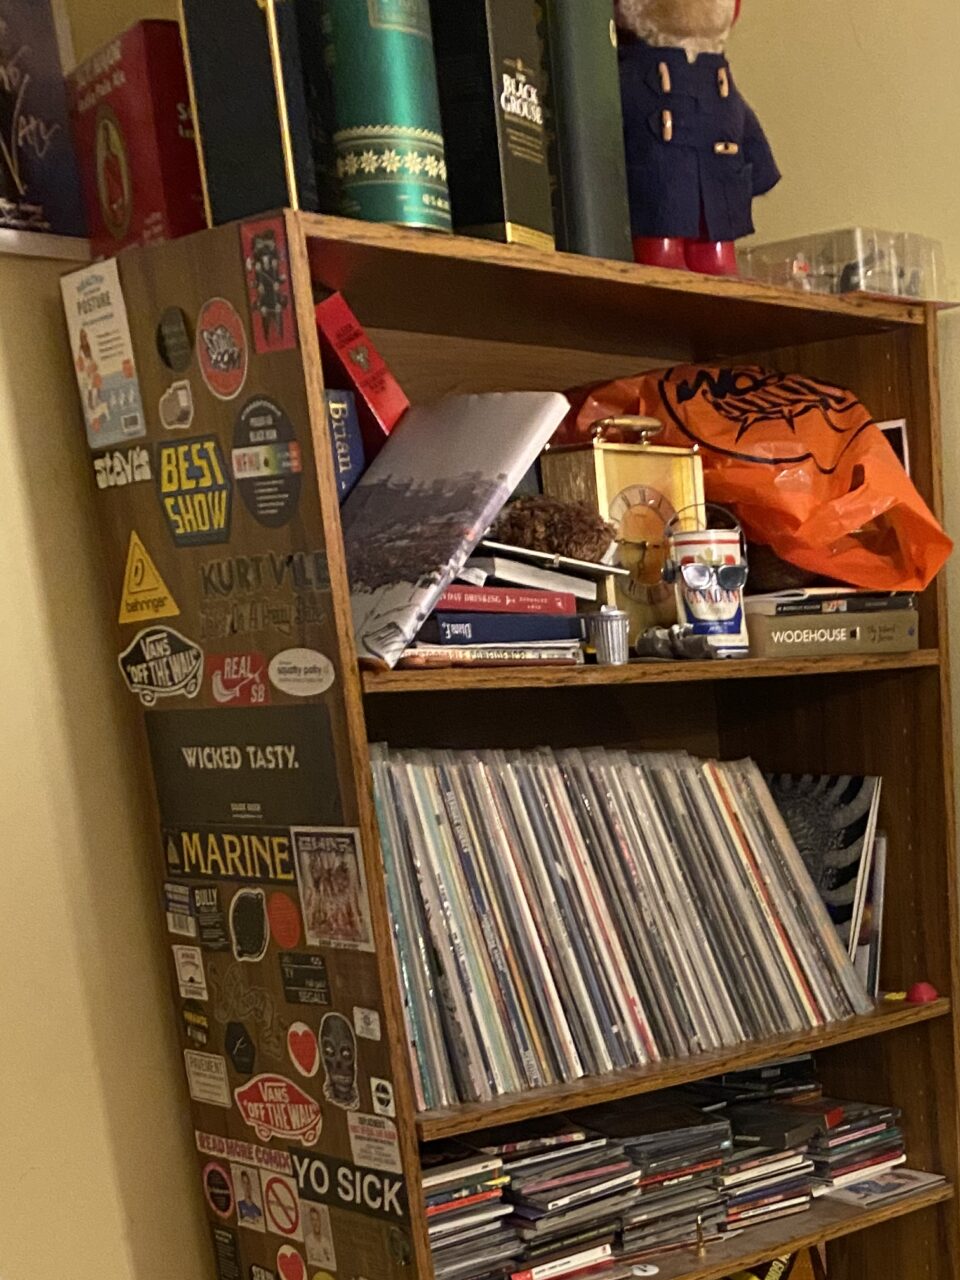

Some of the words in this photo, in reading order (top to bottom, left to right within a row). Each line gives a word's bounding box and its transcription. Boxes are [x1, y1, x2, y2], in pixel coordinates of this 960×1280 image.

[502, 73, 539, 106] BLACK
[500, 92, 543, 125] GROUSE
[161, 441, 224, 493] BEST
[164, 490, 228, 534] SHOW
[141, 632, 171, 656] VANS
[772, 628, 847, 643] WODEHOUSE
[223, 656, 252, 680] REAL
[181, 745, 242, 769] WICKED
[246, 745, 299, 769] TASTY.
[181, 831, 294, 880] MARINE
[258, 1082, 288, 1102] VANS
[267, 1103, 291, 1129] THE
[293, 1155, 330, 1194] YO
[337, 1167, 404, 1216] SICK
